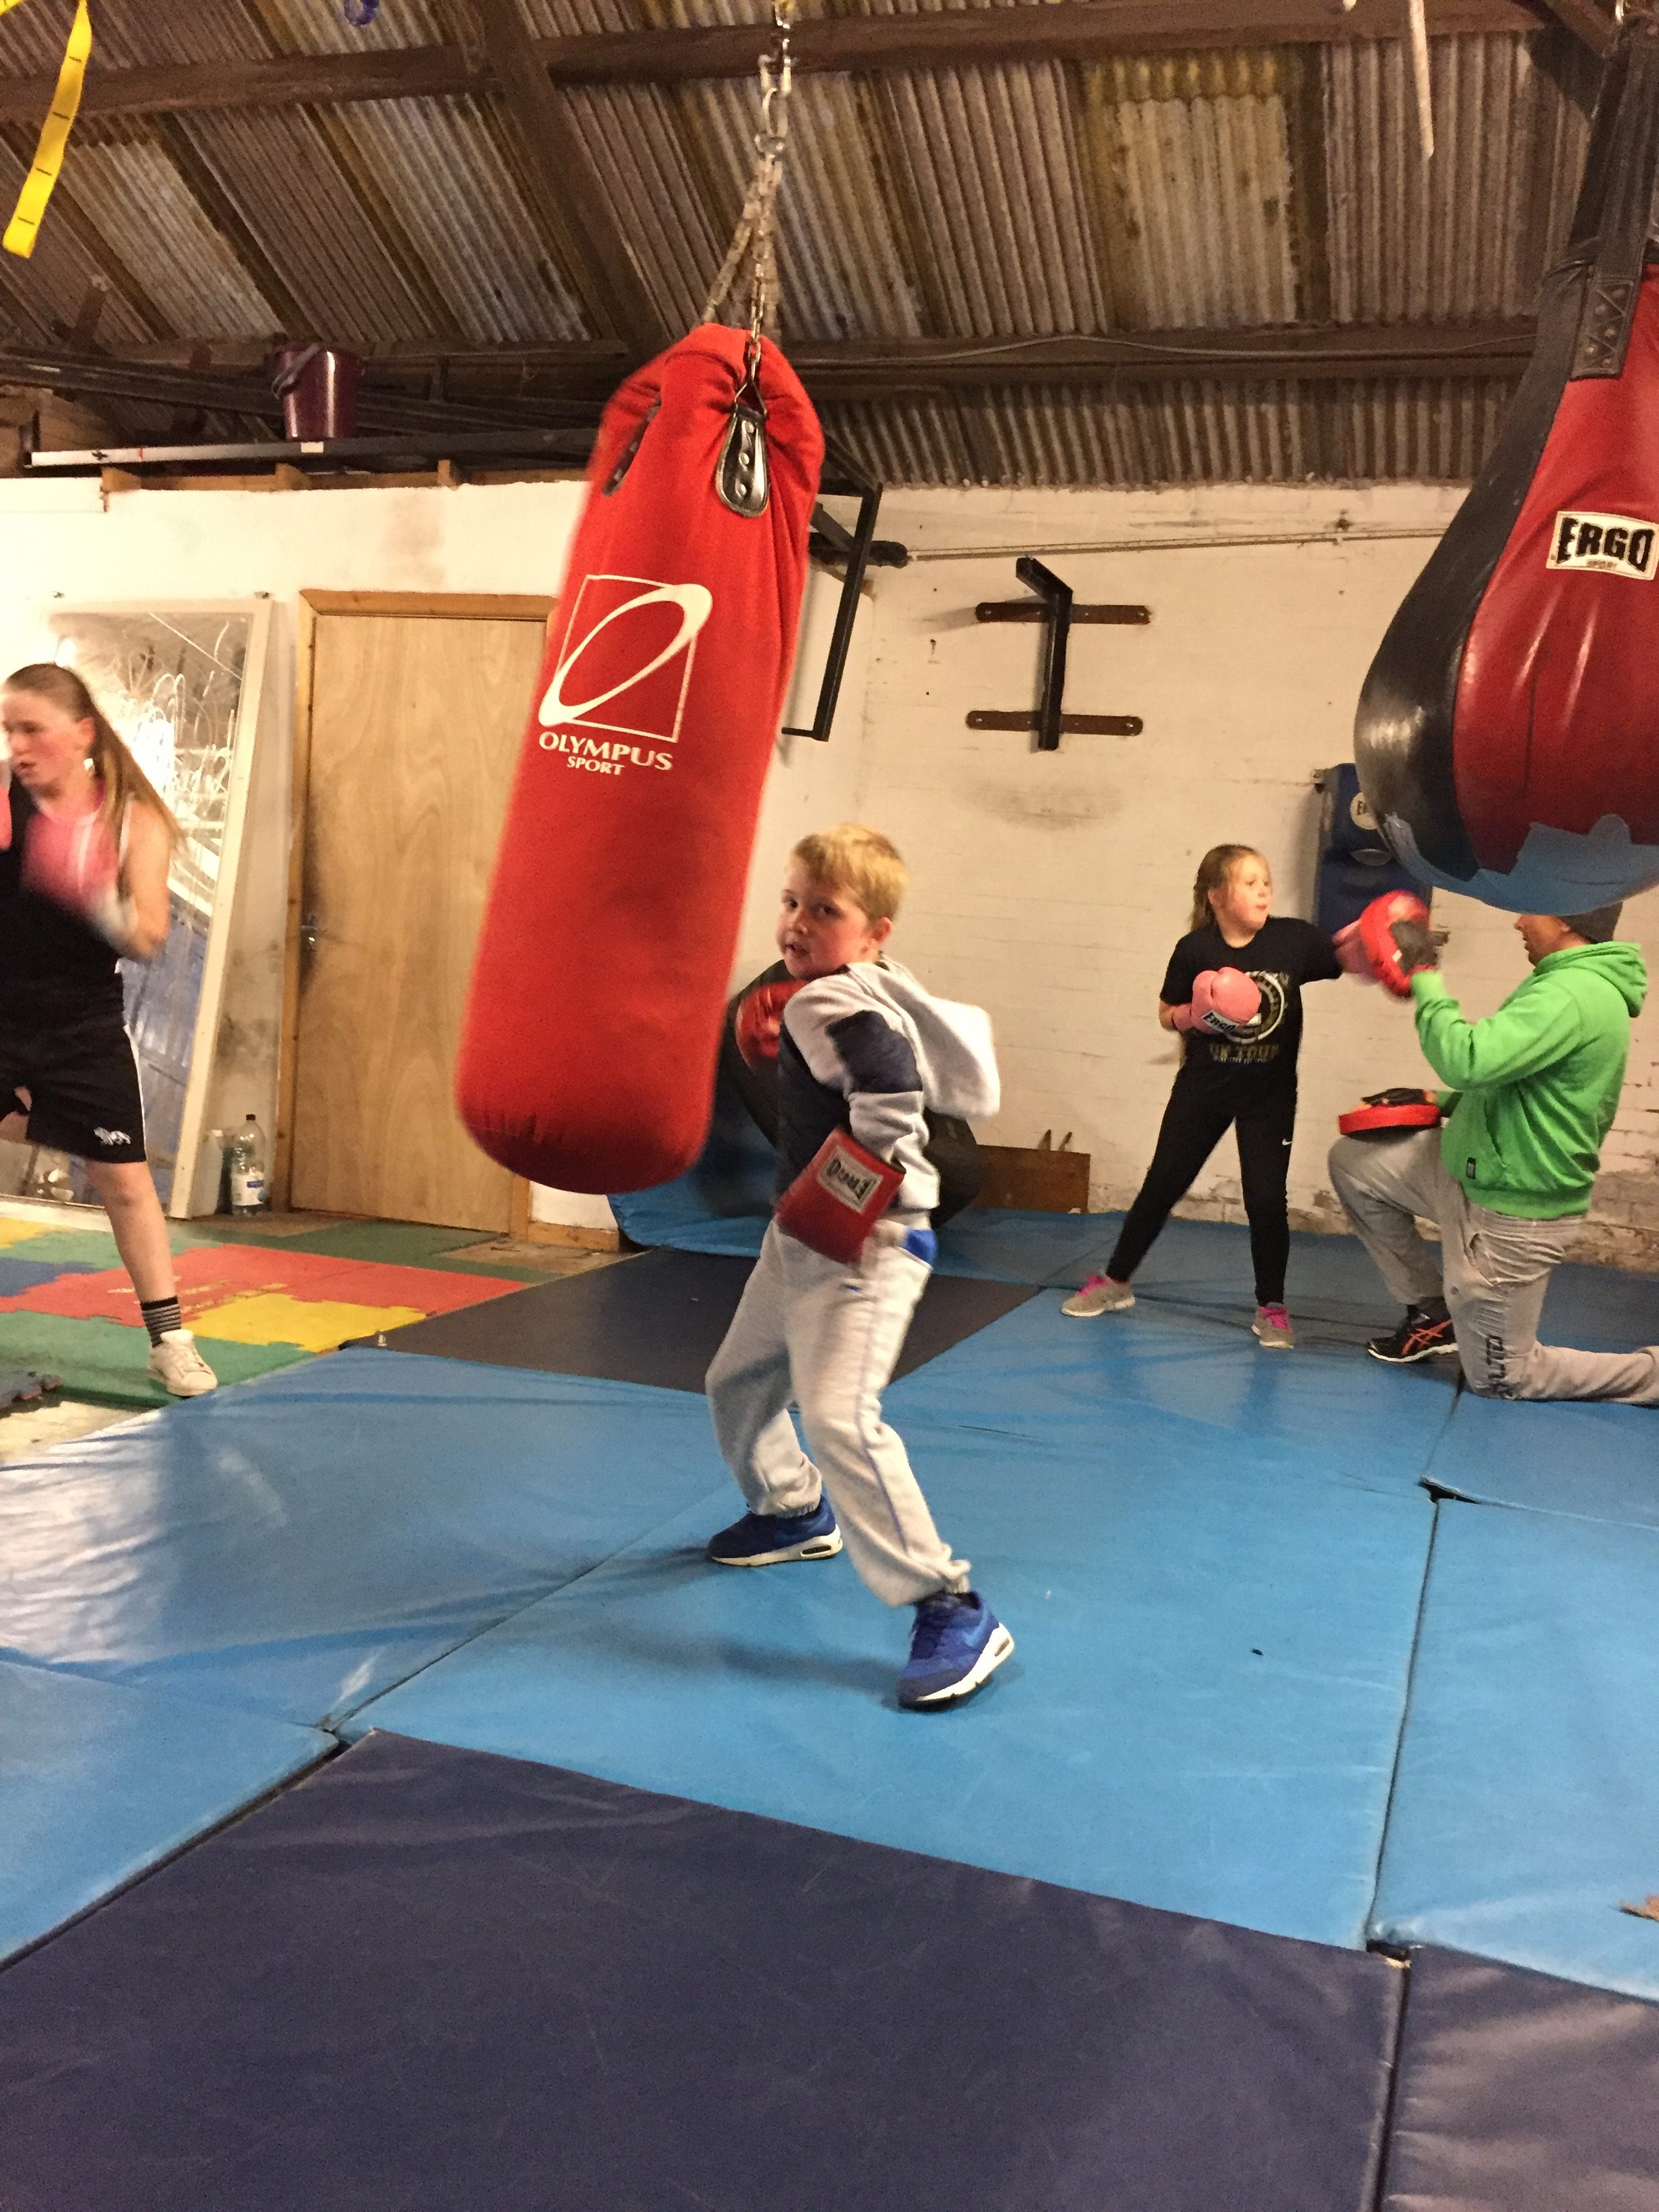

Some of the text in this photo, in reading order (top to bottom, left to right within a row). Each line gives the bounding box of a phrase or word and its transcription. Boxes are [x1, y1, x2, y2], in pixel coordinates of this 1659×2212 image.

[1556, 516, 1656, 572] ERGO
[539, 731, 673, 771] OLYMPUS
[567, 755, 625, 775] SPORT
